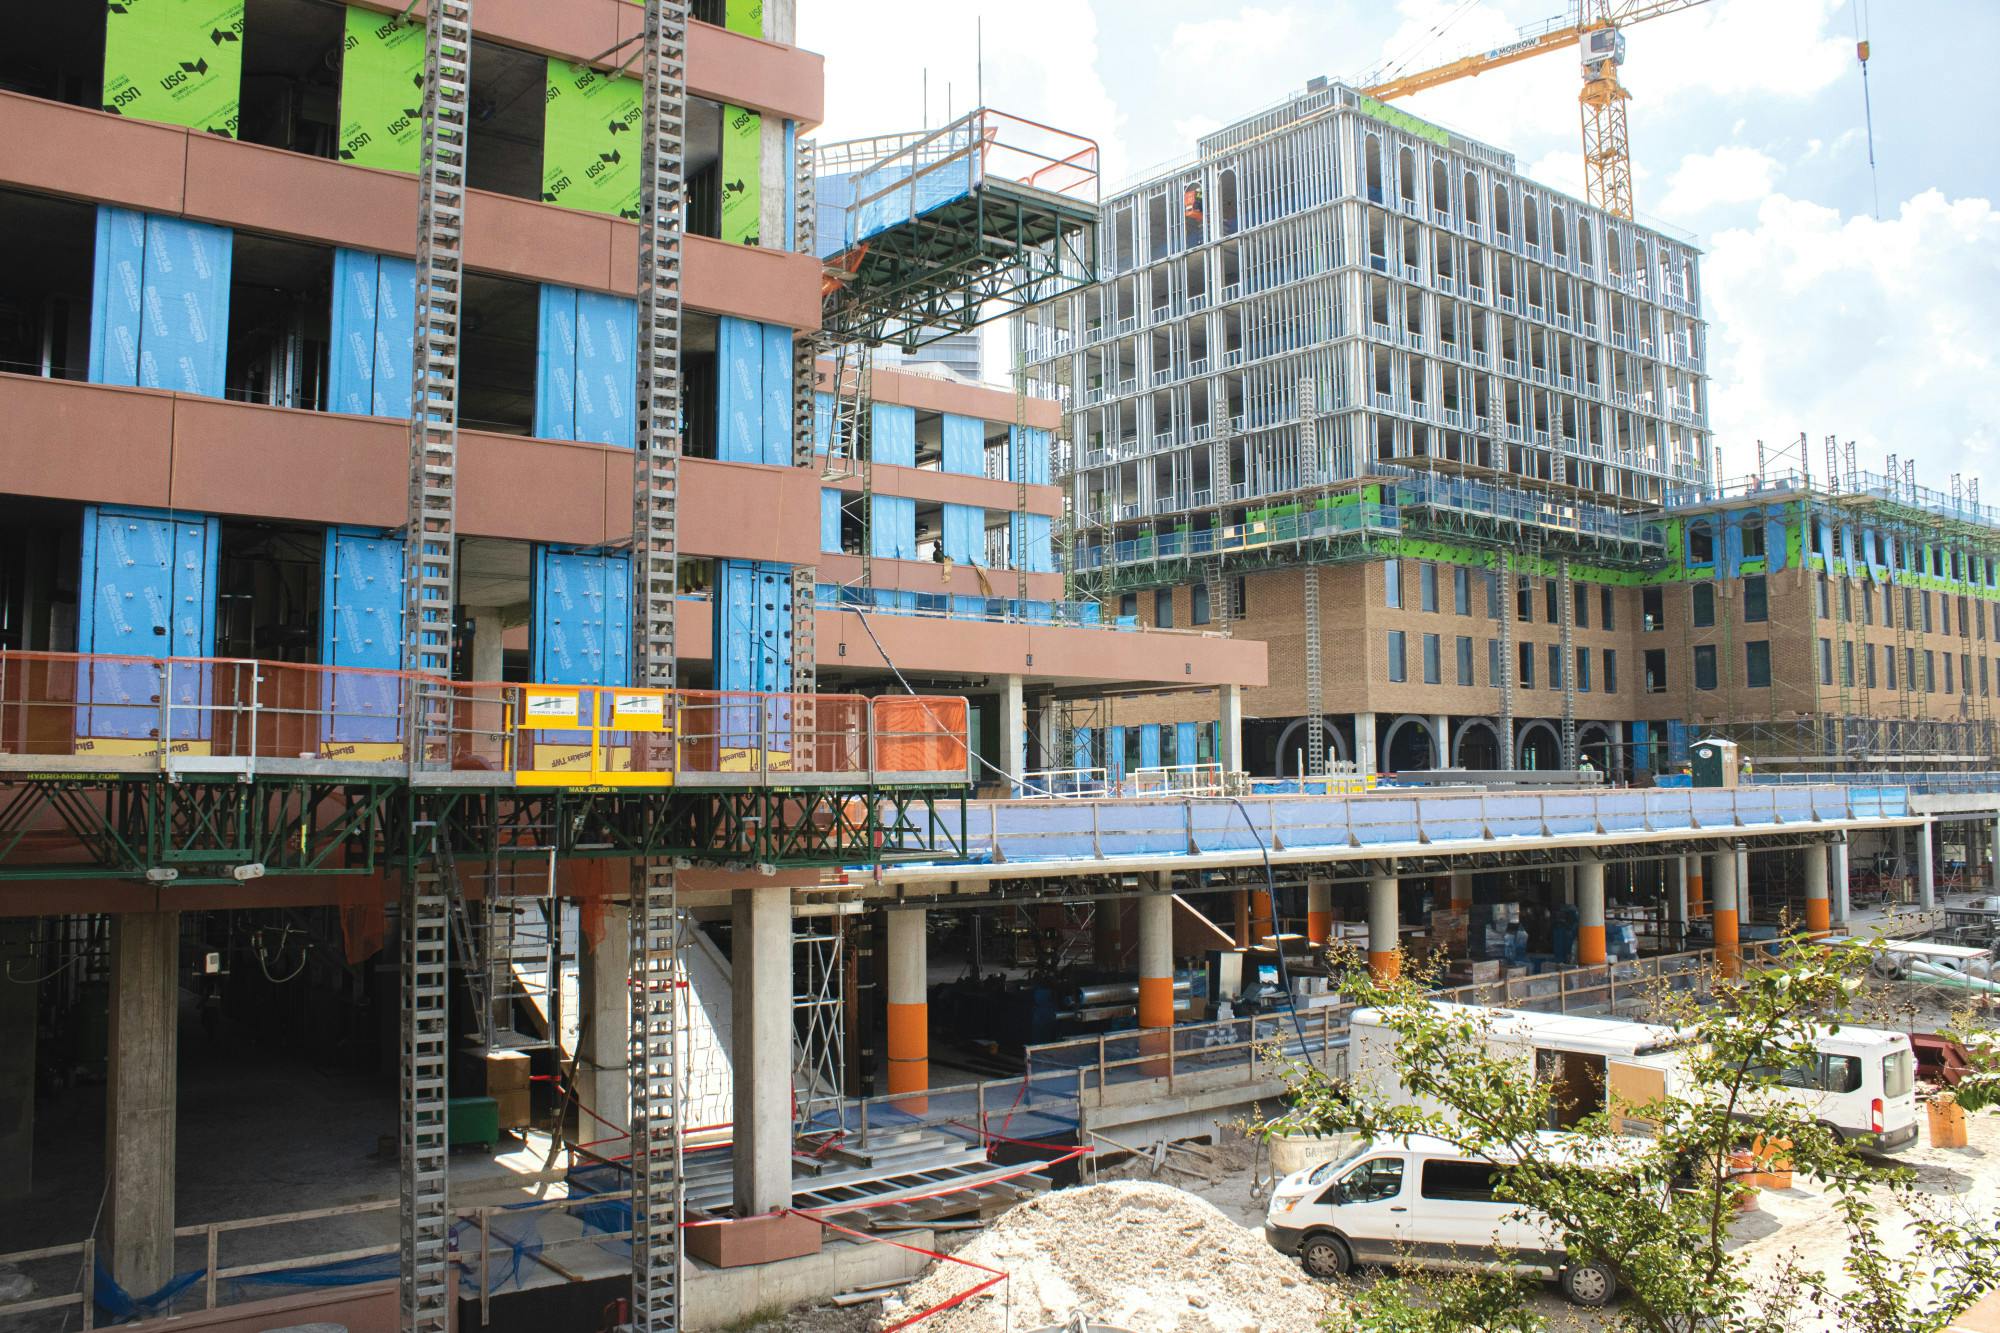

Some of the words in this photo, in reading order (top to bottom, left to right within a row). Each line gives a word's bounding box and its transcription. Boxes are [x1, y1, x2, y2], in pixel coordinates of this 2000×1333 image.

[374, 21, 398, 40] USG
[344, 35, 360, 52] US
[1498, 38, 1536, 55] MORROW
[160, 70, 188, 91] USG
[574, 72, 595, 90] USG
[113, 86, 142, 107] USG
[624, 106, 643, 125] USG
[732, 113, 750, 130] USG
[387, 117, 411, 136] USG
[347, 132, 372, 152] USG
[585, 160, 606, 179] USG
[550, 176, 572, 195] USG
[551, 756, 566, 767] TWF
